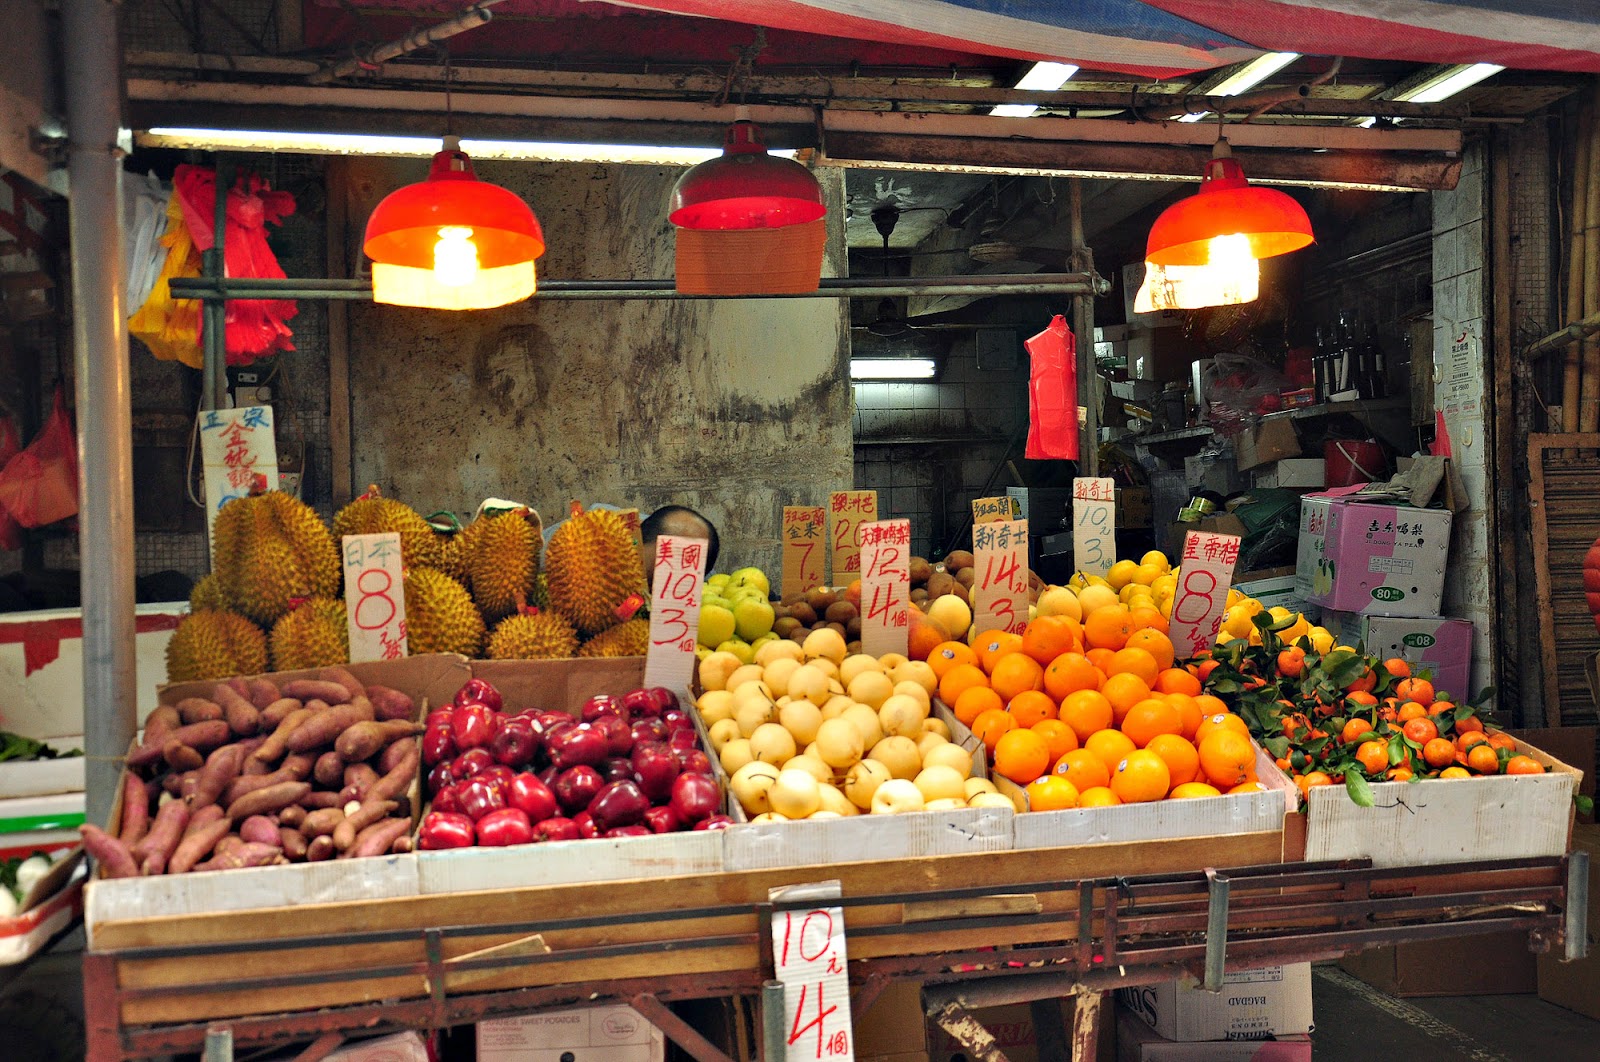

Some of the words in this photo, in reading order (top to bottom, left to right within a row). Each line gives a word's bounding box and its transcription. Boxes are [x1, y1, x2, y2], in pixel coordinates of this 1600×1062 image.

[1075, 480, 1113, 501] 新奇士
[975, 524, 1027, 550] 新奇士
[346, 537, 401, 567] 日本
[655, 539, 701, 571] 美國
[1376, 588, 1391, 599] 80
[1228, 996, 1266, 1006] BAGDAD
[1231, 1021, 1269, 1030] LEMONS
